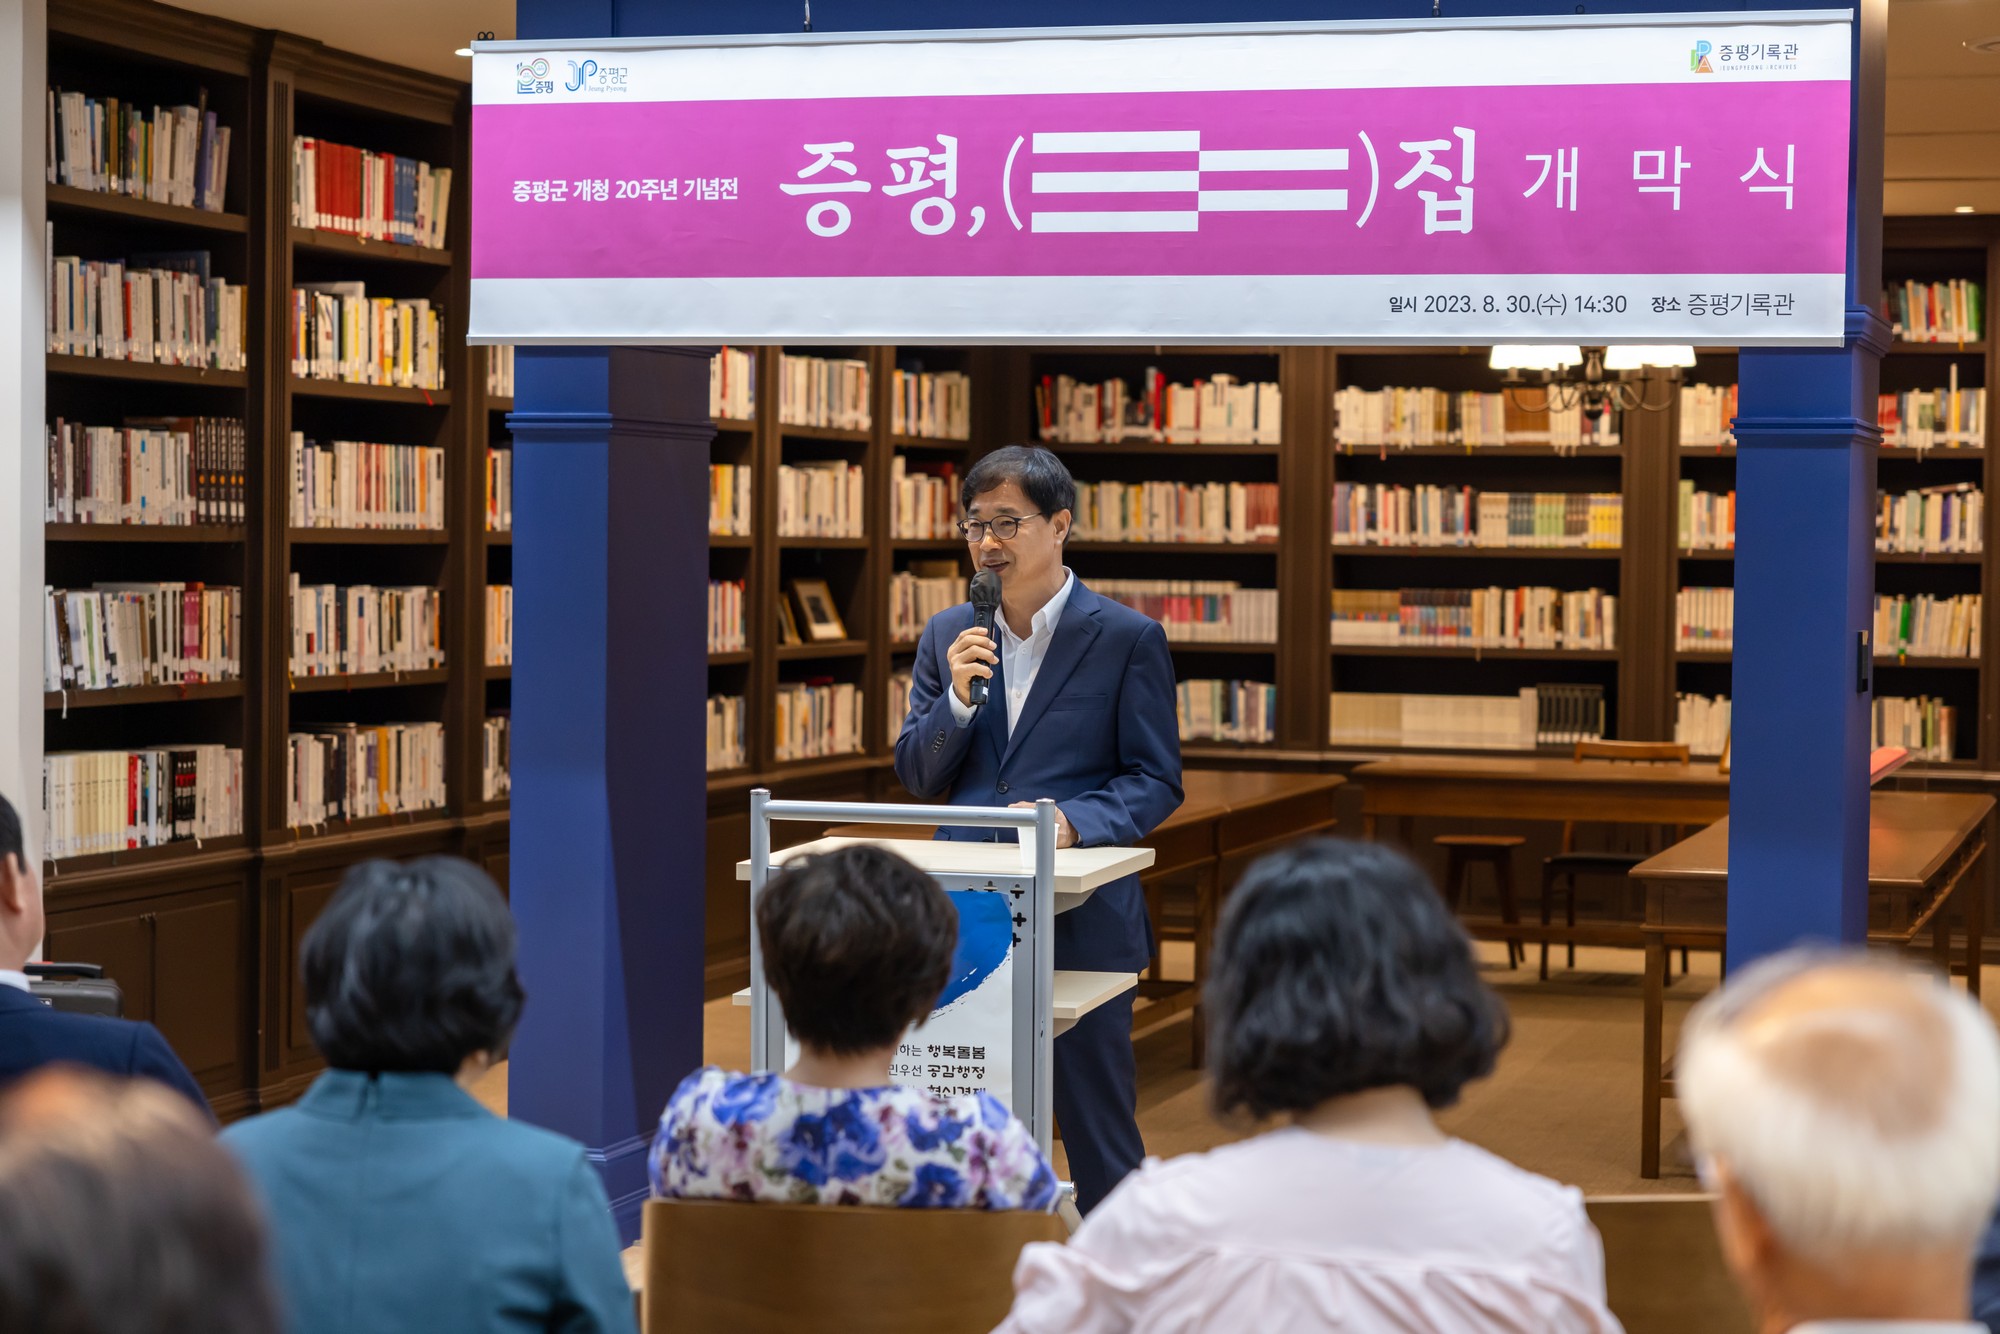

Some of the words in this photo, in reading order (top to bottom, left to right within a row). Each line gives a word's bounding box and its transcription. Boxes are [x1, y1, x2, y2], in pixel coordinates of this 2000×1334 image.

[1719, 43, 1799, 62] 증평기록관
[599, 67, 628, 85] 증평군
[535, 80, 554, 94] 증평
[512, 180, 569, 203] 증평군
[573, 178, 610, 202] 개청
[615, 177, 678, 202] 20주년
[683, 177, 739, 201] 기념전
[1389, 296, 1417, 313] 일시
[1424, 295, 1477, 313] 2023.
[1482, 295, 1500, 313] 8.
[1506, 293, 1567, 316] 30.(수)
[1574, 295, 1627, 313] 14:30
[1651, 296, 1682, 313] 장소
[1687, 292, 1795, 317] 증평기록관
[926, 1044, 986, 1060] 행복돌봄
[927, 1064, 986, 1080] 공감행정
